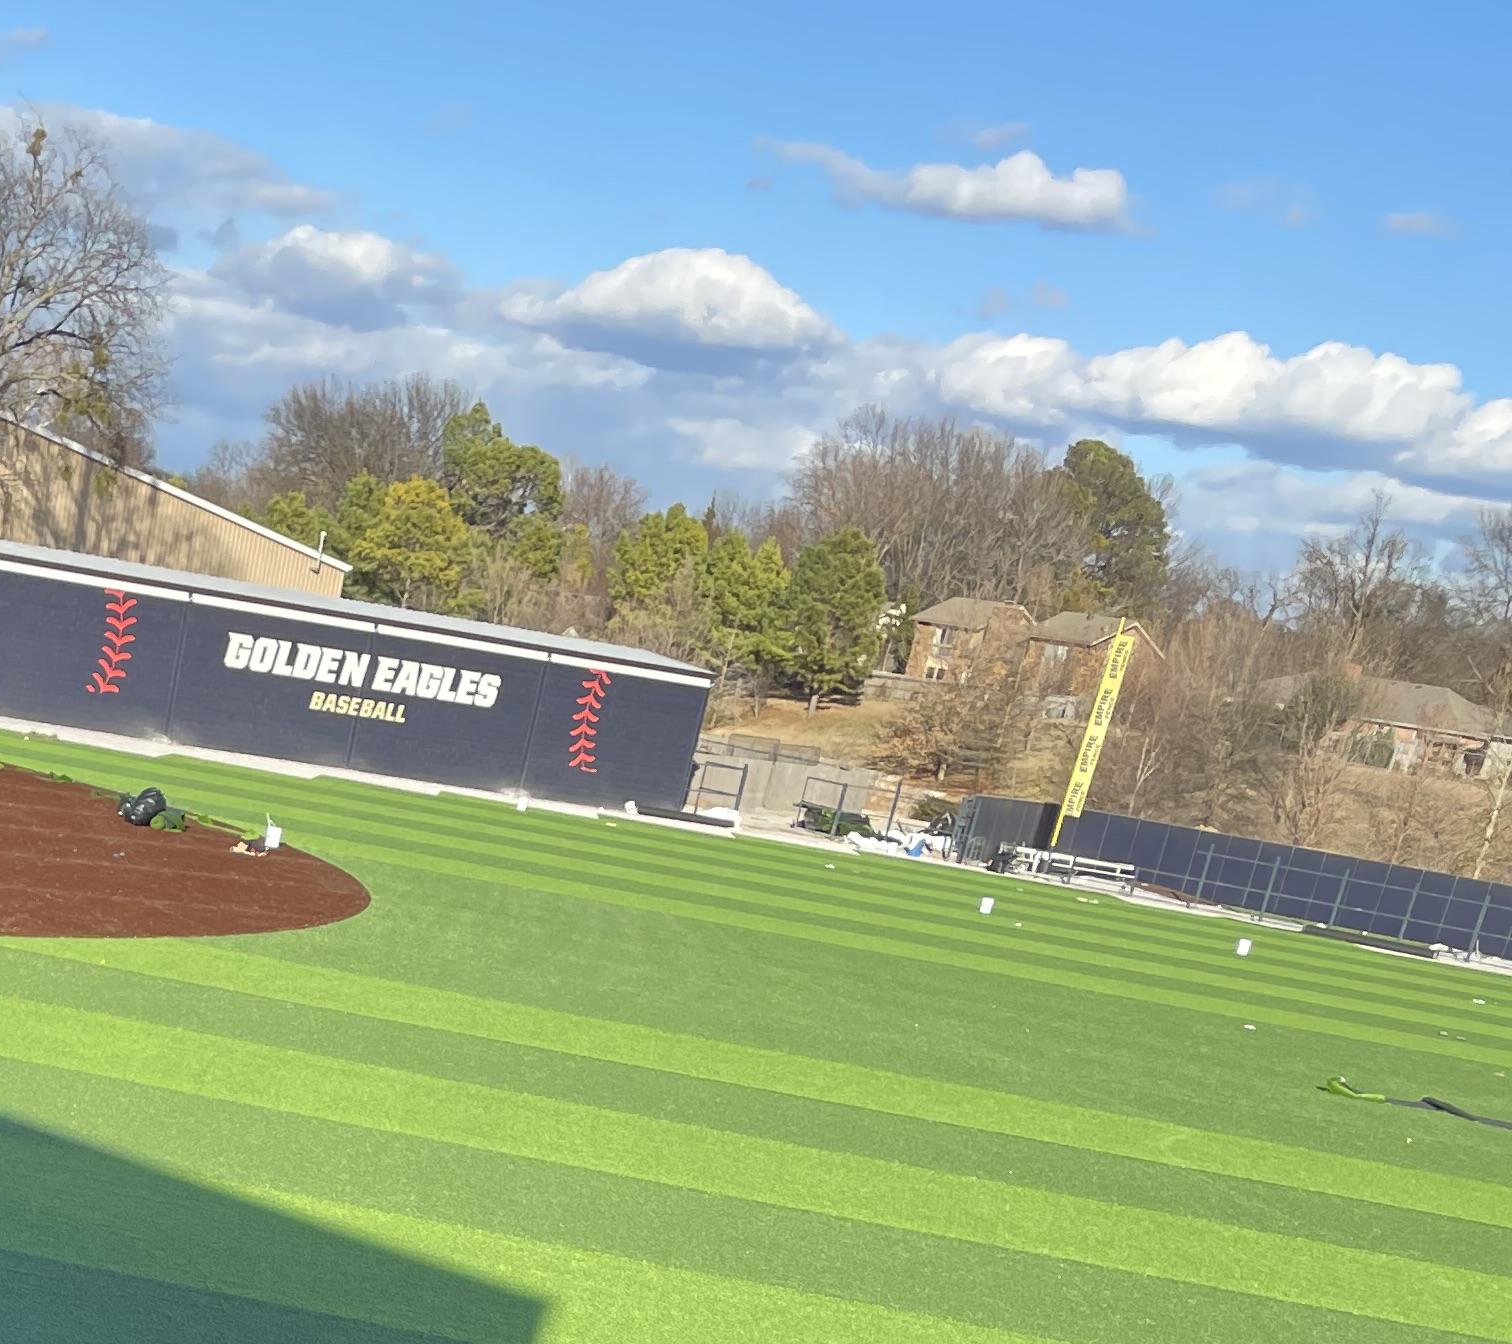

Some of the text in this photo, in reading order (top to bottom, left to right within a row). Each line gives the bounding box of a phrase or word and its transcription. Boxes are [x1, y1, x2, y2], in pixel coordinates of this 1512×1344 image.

[224, 631, 502, 708] GOLDEN EAGLES
[1109, 641, 1128, 679] EMPIRE
[309, 691, 406, 723] BASEBALL
[1094, 687, 1113, 726] EMPIRE
[1080, 735, 1098, 773] EMPIRE
